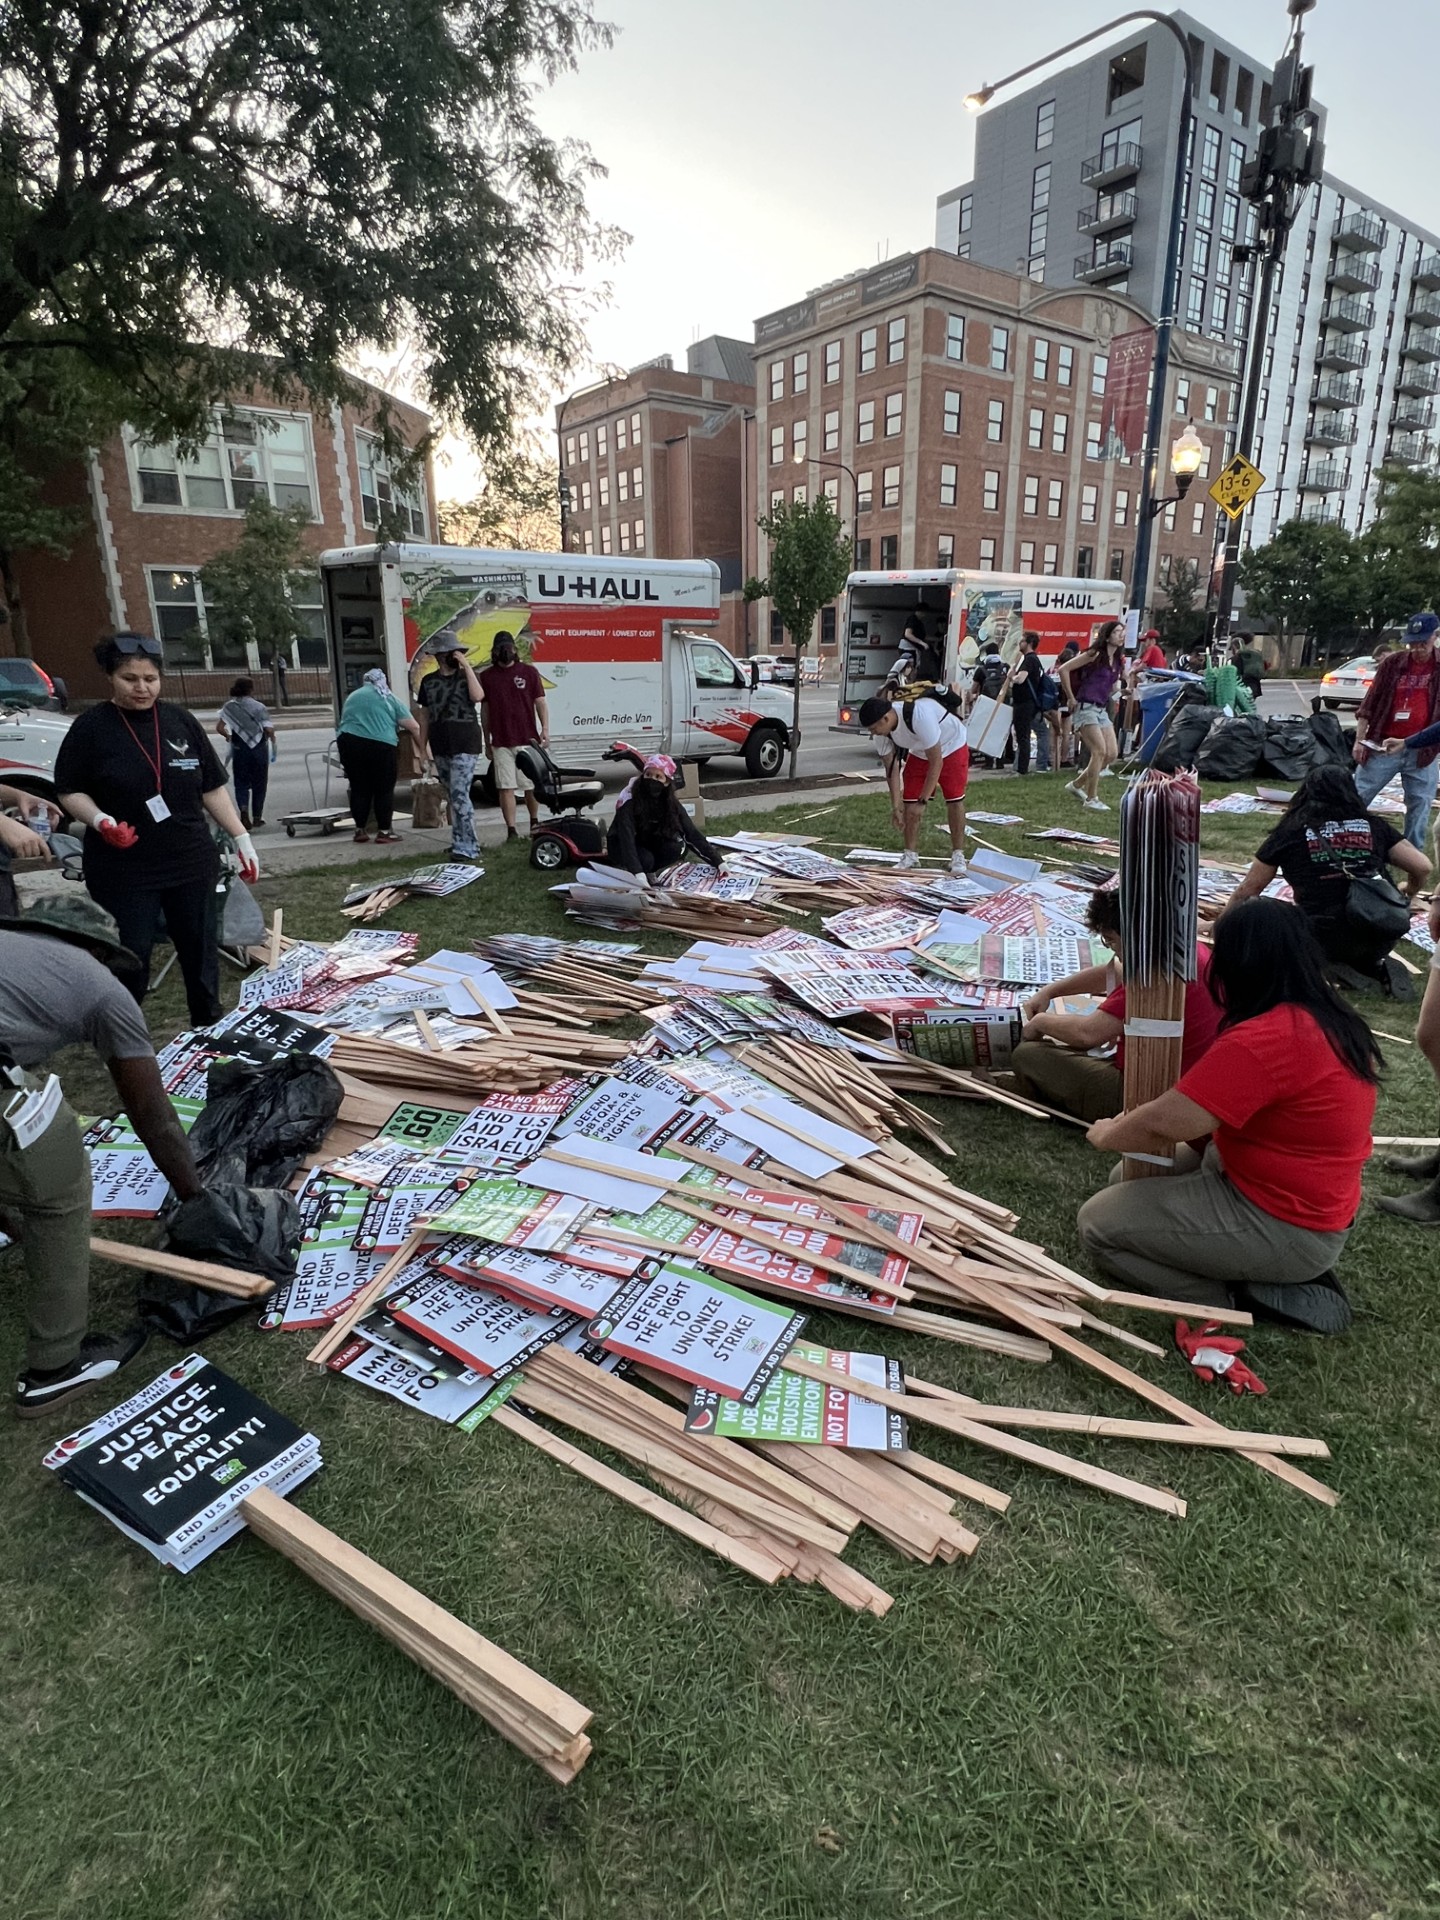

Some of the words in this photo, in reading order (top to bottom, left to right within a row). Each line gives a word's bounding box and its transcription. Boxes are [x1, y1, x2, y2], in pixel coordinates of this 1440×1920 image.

[472, 574, 521, 583] WASHINGTON
[538, 574, 659, 600] U-HAUL
[1036, 592, 1094, 609] U-HAUL
[635, 713, 652, 723] Van
[860, 922, 906, 939] FREE
[814, 953, 843, 961] STOP
[852, 952, 893, 961] POLICE
[821, 960, 906, 971] CRIMES
[271, 984, 298, 996] END
[272, 979, 297, 990] AID
[848, 984, 897, 995] THEM
[903, 984, 937, 993] ALL
[851, 974, 908, 984] FREE
[244, 989, 264, 999] TO
[234, 1013, 271, 1036] TICE.
[255, 1023, 280, 1039] CE.
[277, 1027, 306, 1049] LITY!
[546, 1077, 573, 1094] WITH
[483, 1100, 562, 1113] PALESTINE!
[489, 1093, 533, 1104] STAND
[537, 1094, 569, 1105] WITH
[441, 1115, 460, 1126] TO
[474, 1110, 513, 1123] END
[519, 1116, 550, 1127] U.S
[574, 1094, 611, 1127] DEFEND
[580, 1100, 619, 1136] GBTQIA+
[618, 1091, 629, 1099] &
[593, 1091, 642, 1138] PRODUCTIVE
[402, 1110, 442, 1138] GO
[462, 1122, 504, 1136] AID
[512, 1127, 542, 1141] TO
[661, 1130, 670, 1138] TO
[451, 1134, 534, 1156] ISRAEL!
[683, 1135, 693, 1144] TO
[706, 1130, 734, 1153] RIGH
[368, 1148, 395, 1163] FEND
[101, 1171, 118, 1185] TO
[102, 1155, 144, 1203] UNIONIZE
[127, 1167, 147, 1188] AND
[441, 1171, 457, 1181] TO
[408, 1192, 427, 1217] RIGHT
[467, 1188, 482, 1202] FOR
[510, 1190, 528, 1206] AND
[360, 1215, 374, 1235] STAND
[386, 1198, 409, 1235] DEFEND
[507, 1223, 530, 1245] NOT
[523, 1211, 540, 1227] FOR
[538, 1195, 561, 1214] WAR!
[576, 1213, 587, 1225] TO
[642, 1207, 673, 1231] HEALT
[728, 1201, 799, 1272] ISAL
[709, 1234, 737, 1262] STOP
[317, 1252, 336, 1287] RIGHT
[510, 1258, 537, 1274] THE
[542, 1261, 572, 1285] UNIO
[767, 1265, 790, 1279] &
[294, 1262, 317, 1309] DEFEND
[335, 1271, 350, 1289] TO
[406, 1275, 434, 1295] STAND
[310, 1291, 329, 1314] THE
[421, 1280, 462, 1308] DEFE
[423, 1299, 455, 1320] THE
[454, 1285, 480, 1307] RIG
[460, 1295, 483, 1309] TO
[602, 1294, 625, 1318] STAND
[623, 1278, 641, 1295] WITH
[612, 1282, 648, 1320] PALESTINE!
[327, 1296, 356, 1316] STAND
[450, 1295, 511, 1333] UNIONIZ
[625, 1284, 669, 1331] DEFEND
[635, 1322, 662, 1344] THE
[661, 1281, 691, 1319] RIGHT
[482, 1306, 513, 1329] AND
[485, 1307, 536, 1343] STRIKE
[669, 1310, 691, 1328] TO
[671, 1296, 723, 1355] UNIONIZE
[702, 1319, 729, 1348] AND
[713, 1314, 756, 1361] STRIKE!
[333, 1346, 360, 1366] STAND
[492, 1364, 513, 1380] END
[512, 1352, 528, 1366] U.S
[528, 1340, 545, 1355] AID
[542, 1329, 557, 1342] TO
[743, 1384, 761, 1402] END
[757, 1366, 771, 1384] U.S
[765, 1352, 780, 1370] AID
[773, 1343, 787, 1358] TO
[782, 1315, 806, 1343] ISRAEL!
[831, 1353, 848, 1374] AR!
[888, 1359, 900, 1379] ISRAEL!
[403, 1374, 440, 1401] FO
[889, 1379, 900, 1394] TO
[98, 1399, 137, 1425] STAND
[139, 1377, 168, 1398] WITH
[108, 1384, 171, 1428] PALESTINE!
[463, 1411, 483, 1429] END
[482, 1398, 498, 1414] U.S
[496, 1382, 513, 1400] AID
[511, 1371, 524, 1384] TO
[98, 1382, 217, 1464] JUSTICE.
[826, 1412, 844, 1442] NOT
[891, 1414, 902, 1431] U.S
[121, 1404, 225, 1471] PEACE.
[174, 1433, 211, 1462] AND
[891, 1431, 902, 1449] END
[142, 1416, 266, 1506] EQUALITY!
[176, 1520, 203, 1543] END
[204, 1501, 227, 1518] U.S
[229, 1483, 250, 1501] AID
[251, 1470, 269, 1482] TO
[270, 1438, 314, 1471] ISRAEL!
